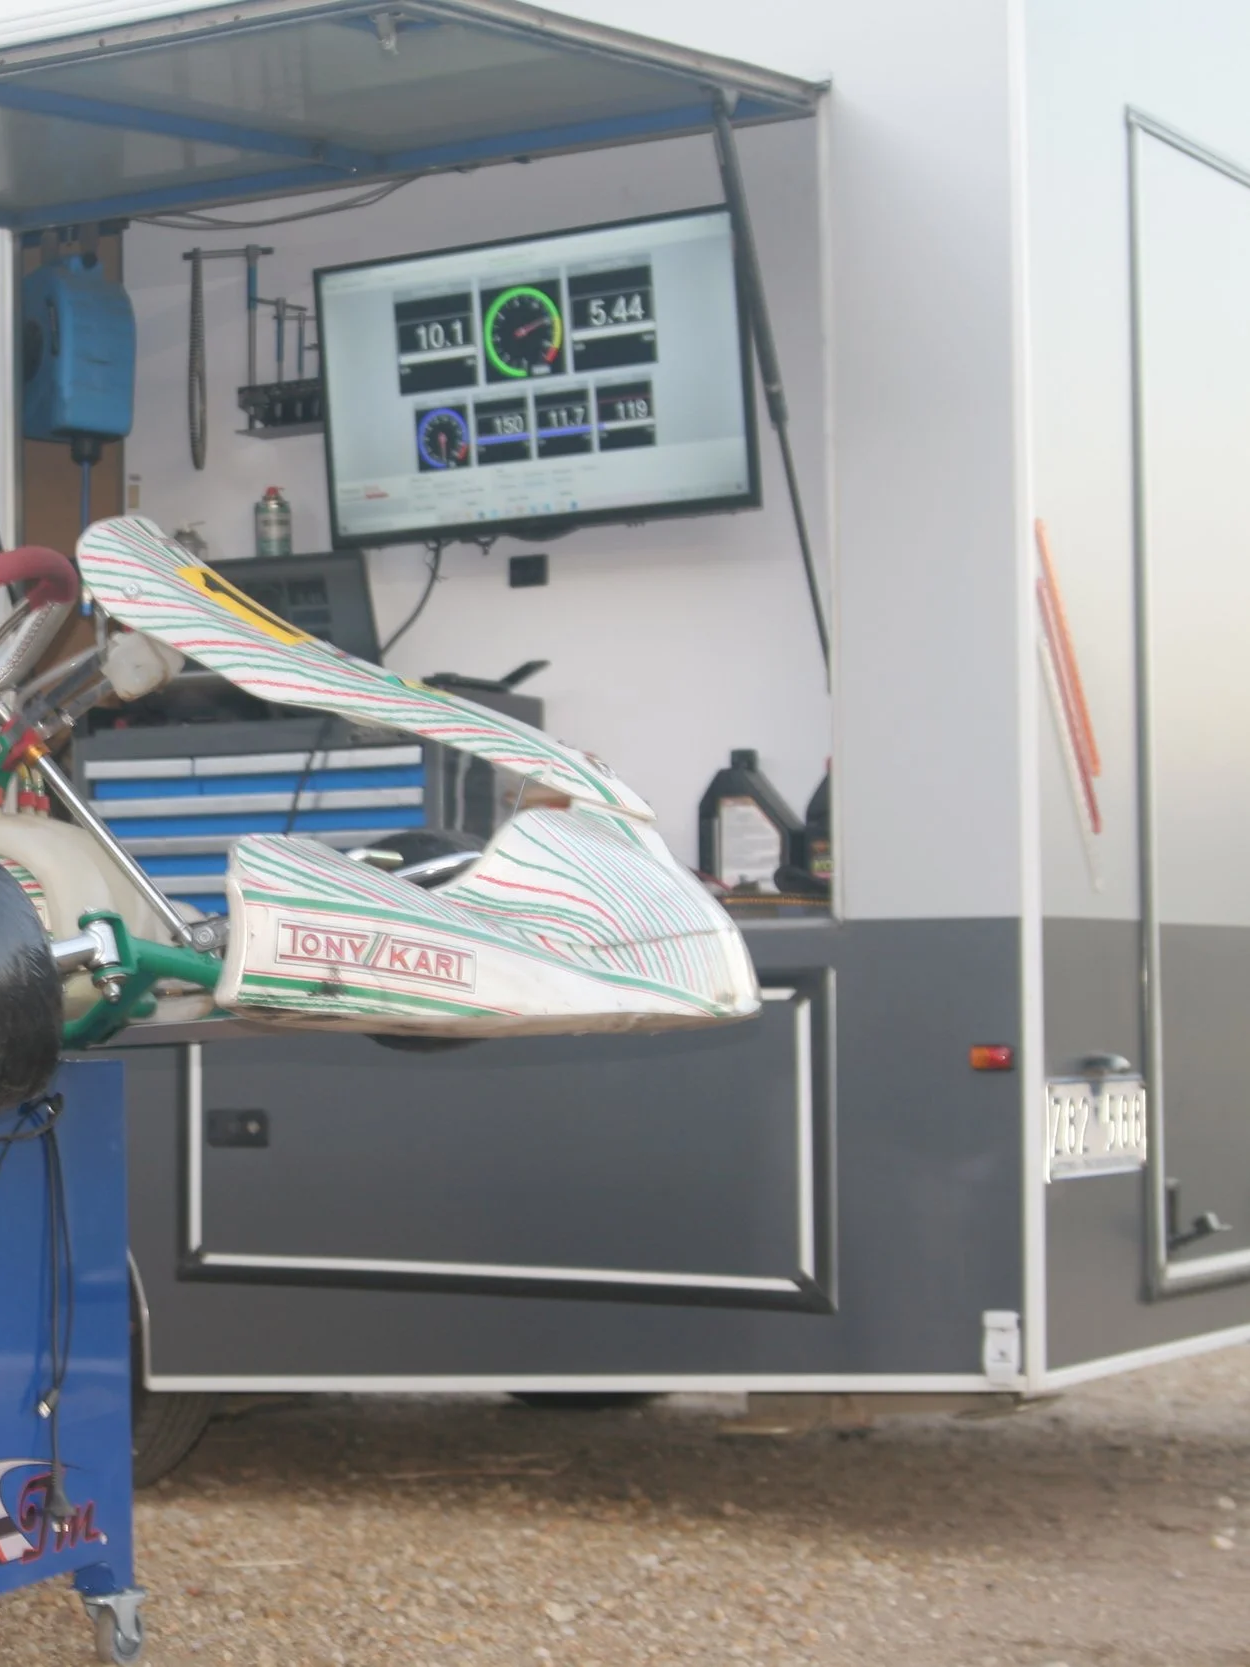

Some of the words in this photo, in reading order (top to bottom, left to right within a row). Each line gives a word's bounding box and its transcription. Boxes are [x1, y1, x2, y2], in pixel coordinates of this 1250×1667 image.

[588, 293, 646, 327] 5.44
[415, 319, 464, 350] 10.1
[548, 406, 586, 428] 11.7
[615, 398, 649, 421] 119
